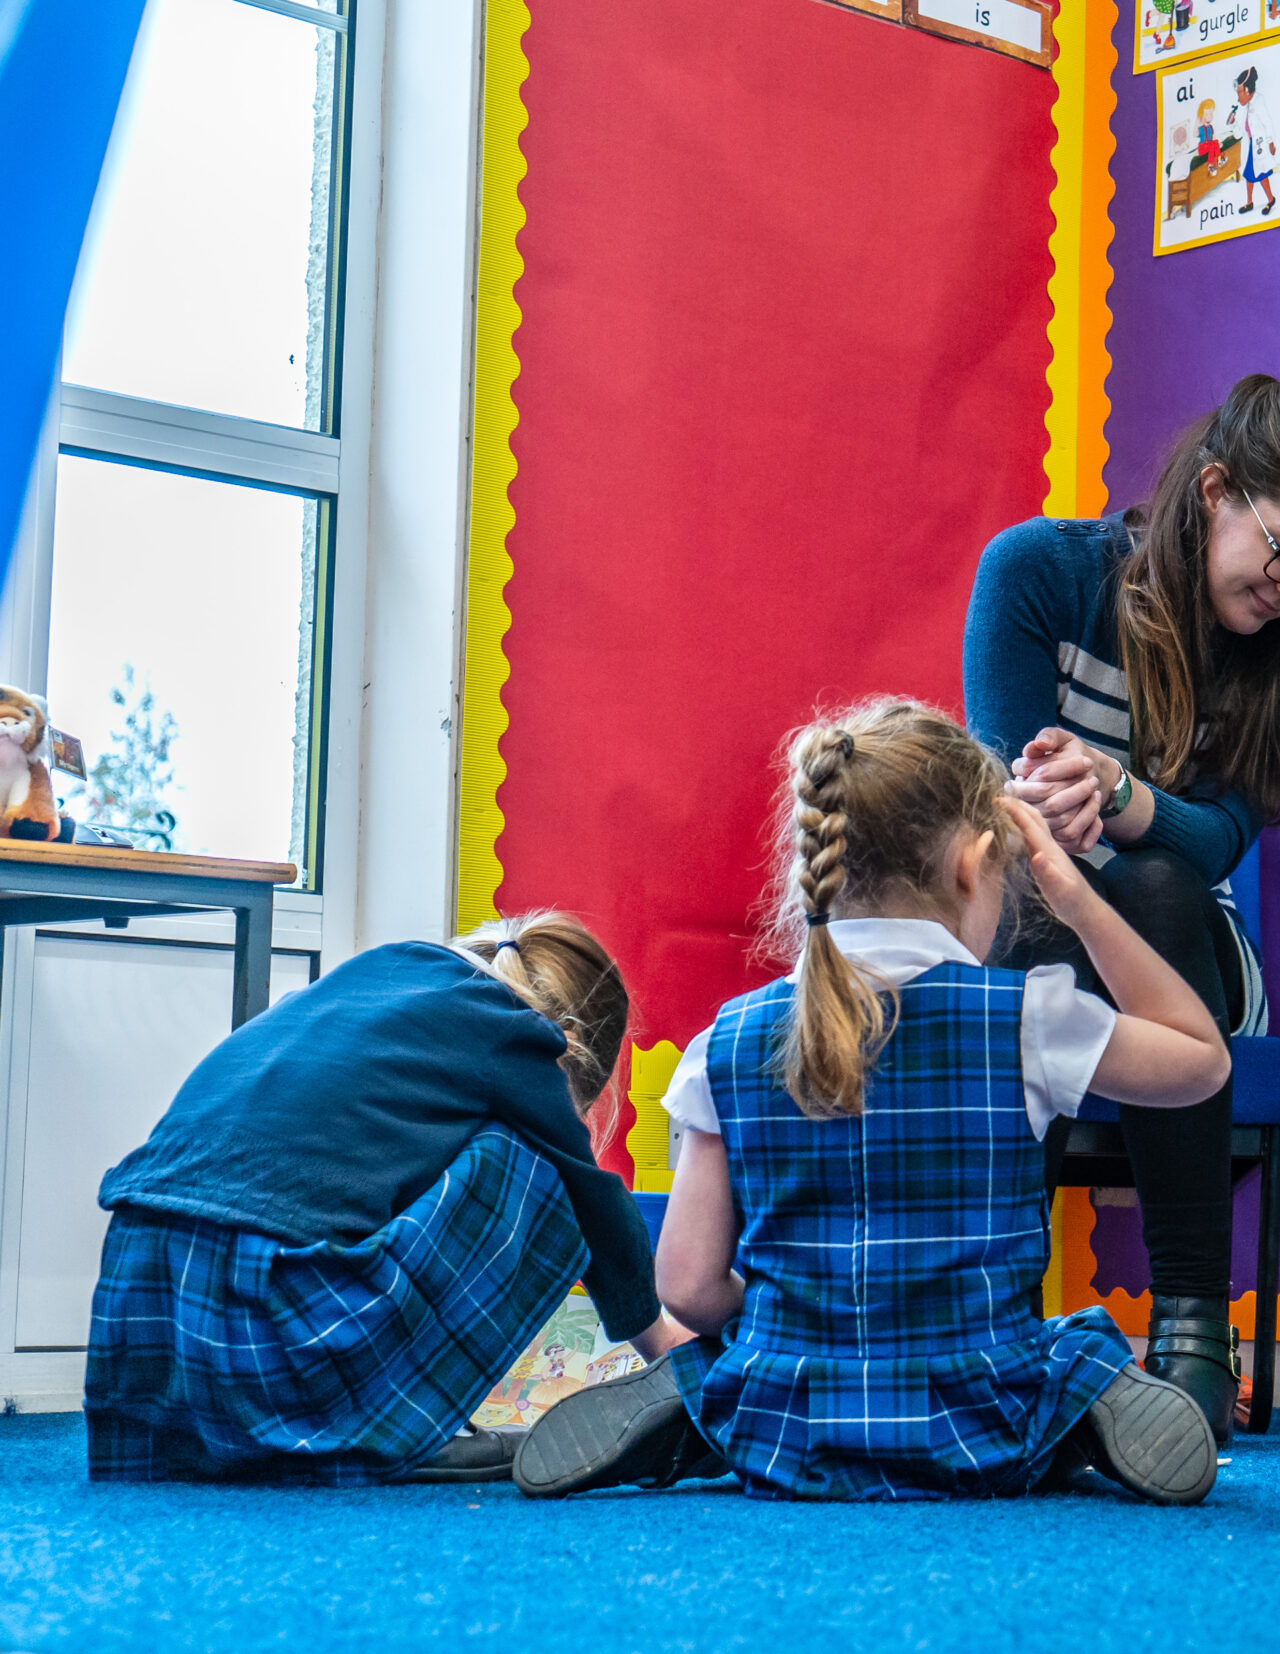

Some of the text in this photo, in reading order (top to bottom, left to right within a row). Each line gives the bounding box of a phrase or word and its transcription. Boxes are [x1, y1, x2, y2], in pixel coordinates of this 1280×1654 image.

[975, 2, 990, 27] is
[1199, 3, 1249, 41] gurgle
[1176, 78, 1195, 103] ai
[1199, 199, 1235, 230] pain
